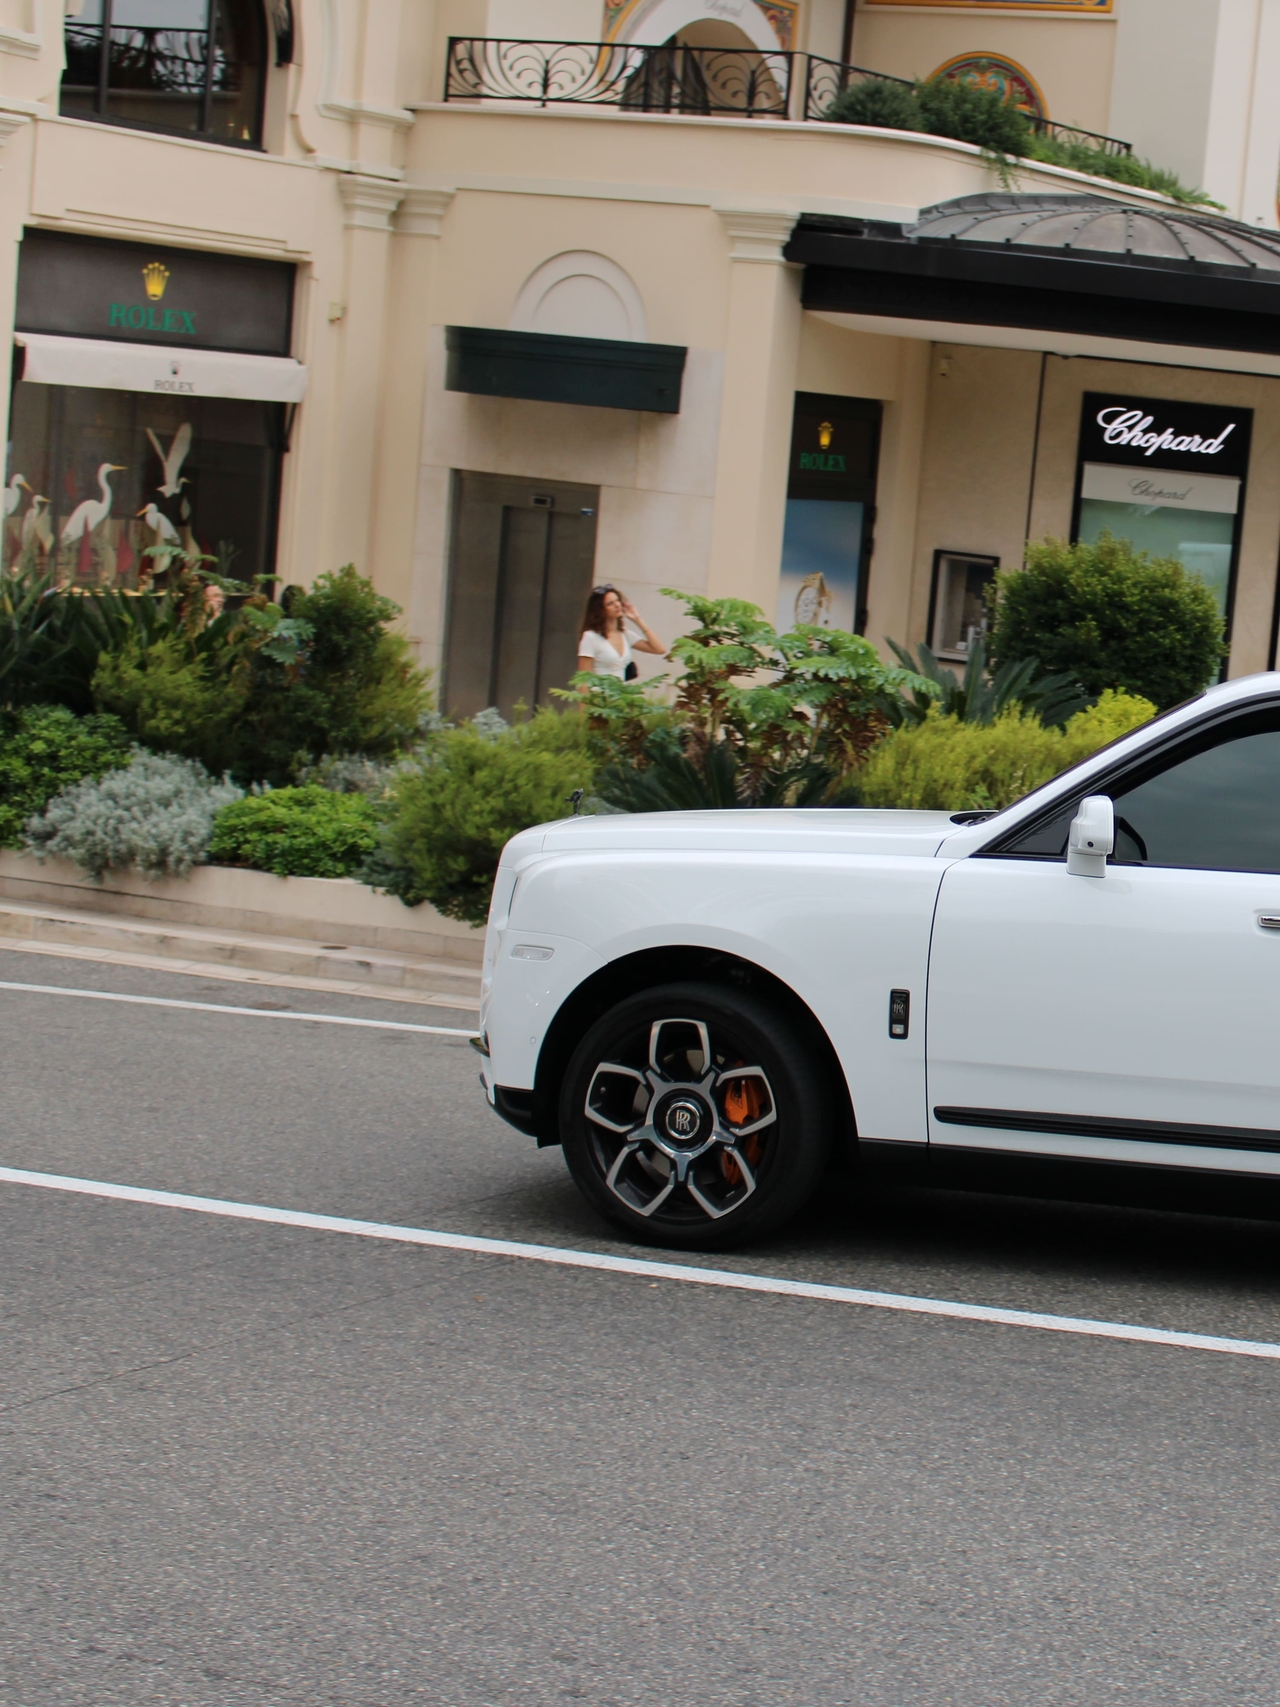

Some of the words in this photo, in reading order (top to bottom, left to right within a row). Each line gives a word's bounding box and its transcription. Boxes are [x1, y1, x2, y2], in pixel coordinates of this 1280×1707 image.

[108, 303, 197, 335] ROLEX
[153, 379, 195, 394] ROLEX
[1096, 406, 1236, 456] Chopard
[799, 452, 847, 472] ROLEX
[1127, 478, 1194, 501] Chopard
